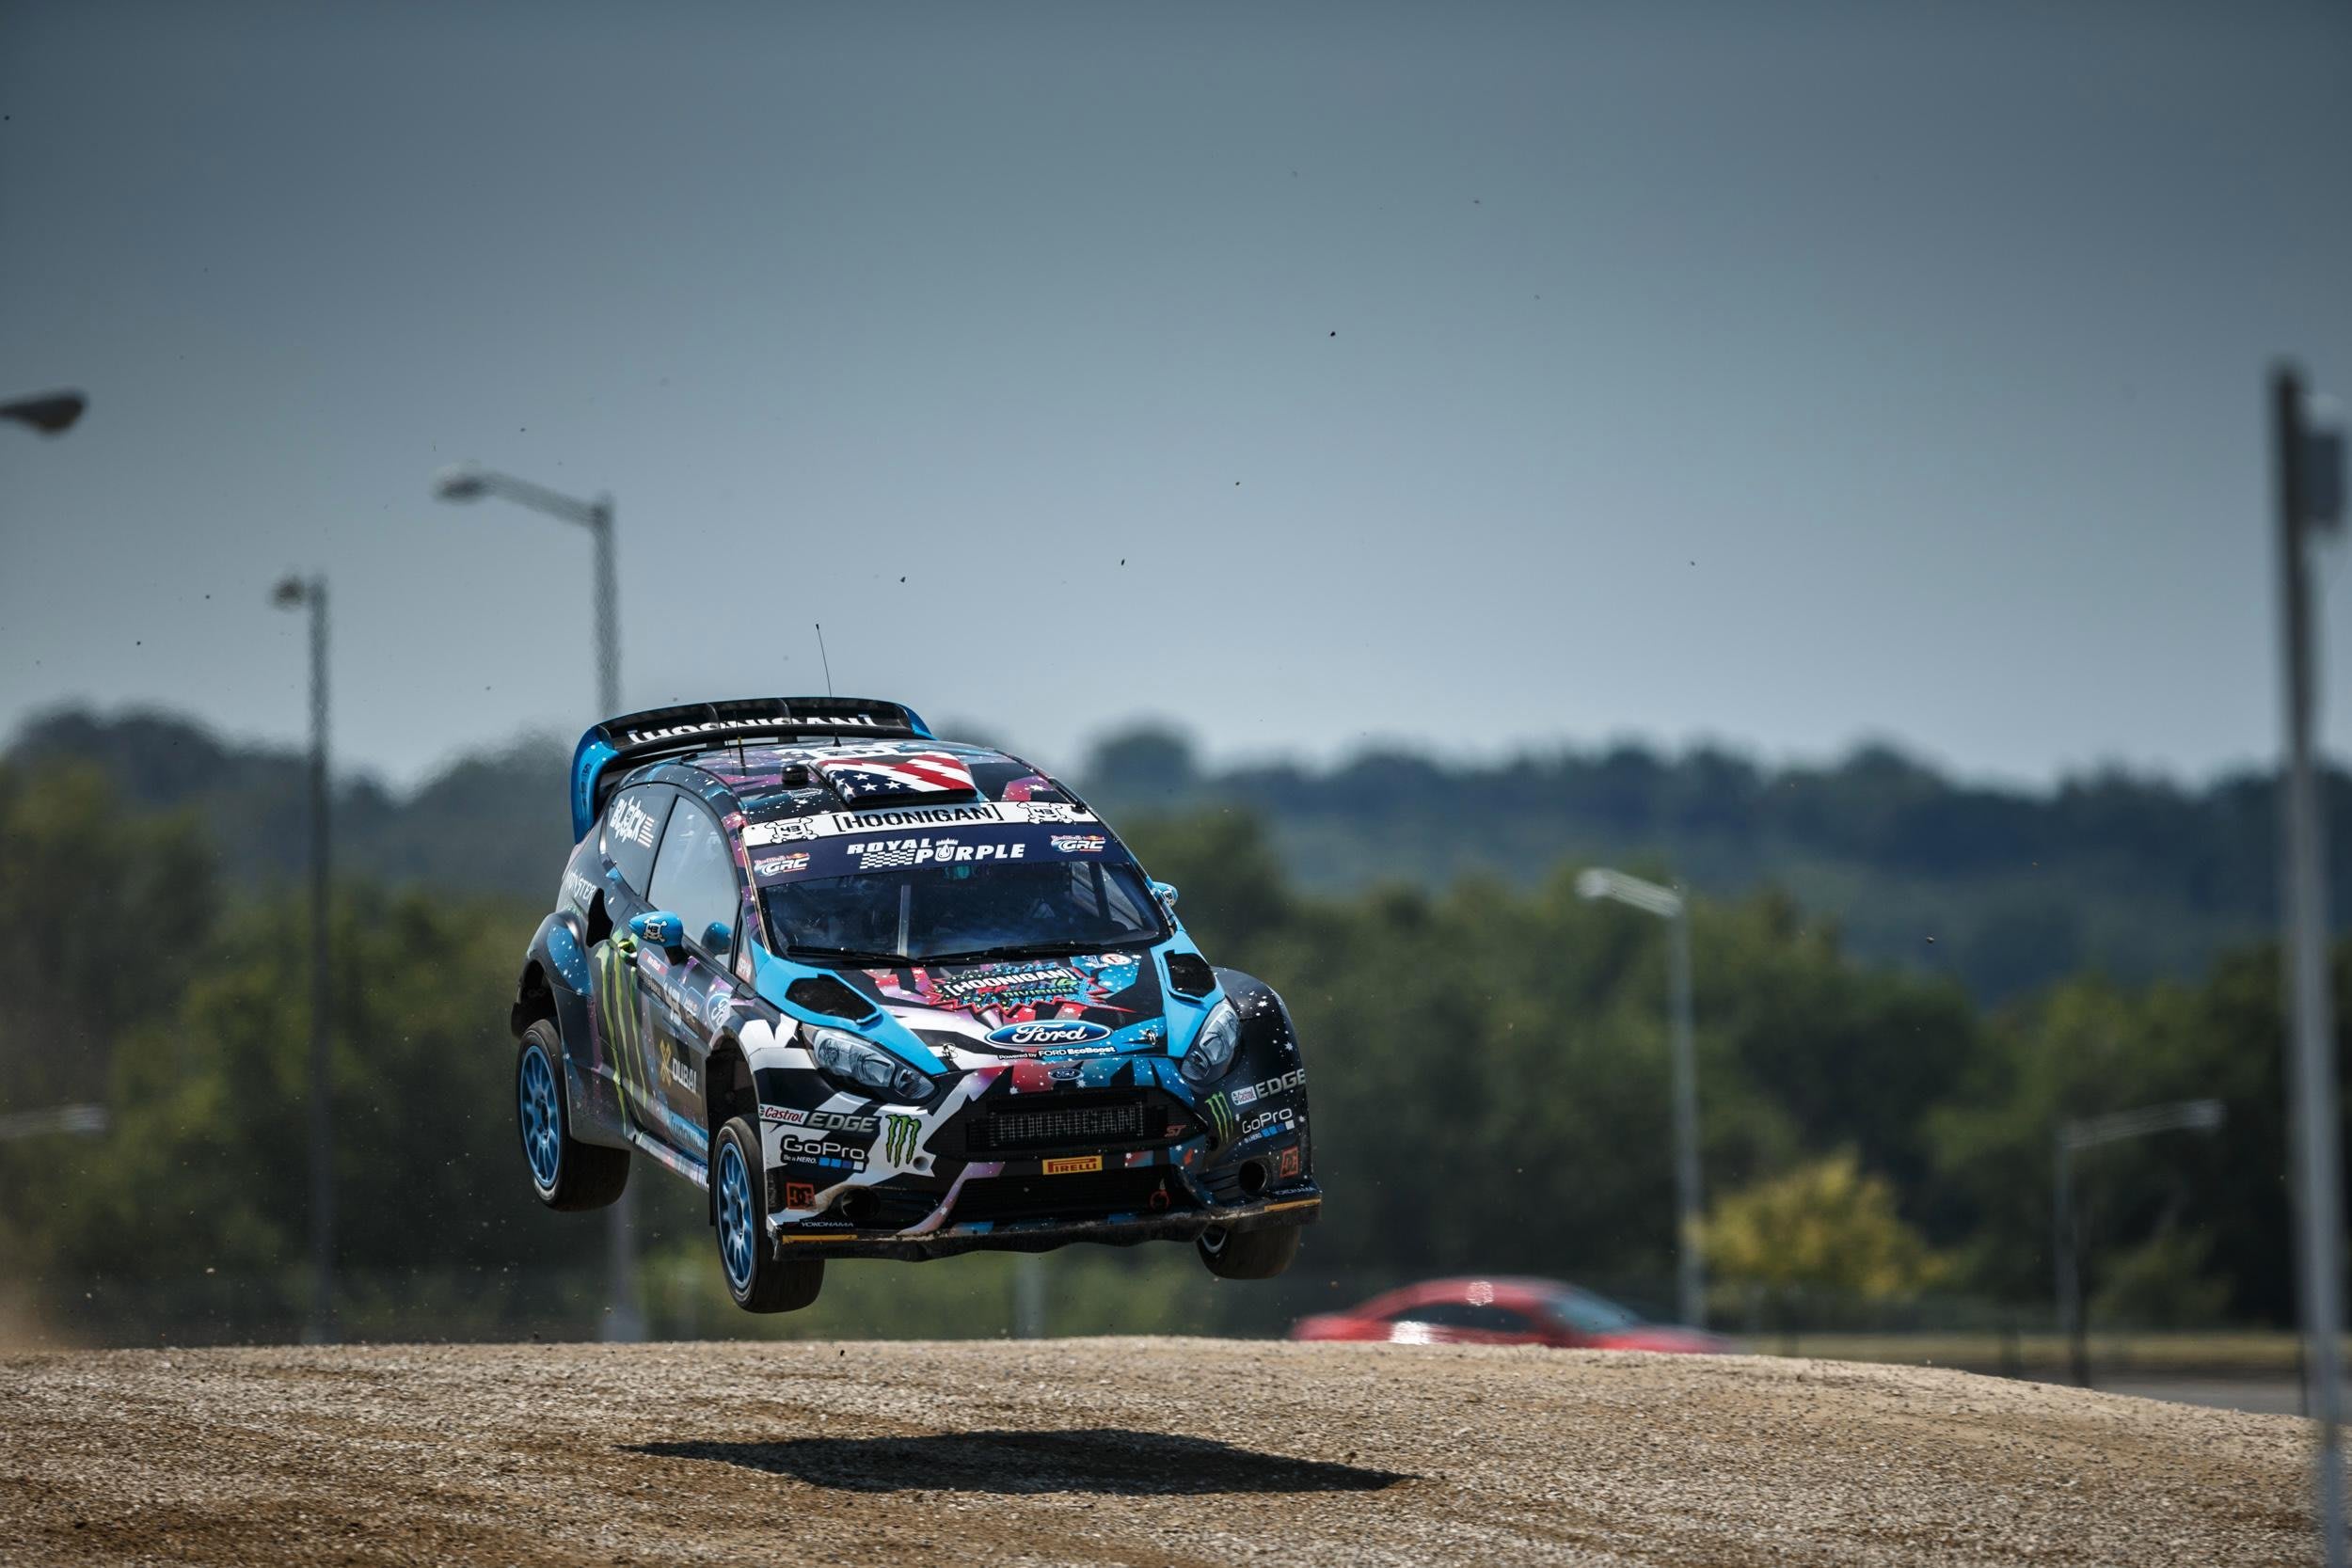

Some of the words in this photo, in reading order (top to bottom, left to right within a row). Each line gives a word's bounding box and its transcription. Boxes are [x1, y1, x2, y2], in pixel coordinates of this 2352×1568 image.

[1035, 807, 1053, 816] 43
[780, 824, 801, 835] 43
[847, 838, 931, 854] ROYAL
[1062, 840, 1106, 850] GRC
[914, 845, 1025, 863] PURPLE
[766, 857, 810, 874] GRC
[1011, 1023, 1088, 1043] Ford
[1068, 1046, 1116, 1054] EcoBoost
[672, 1057, 697, 1094] DUBAI
[1256, 1069, 1306, 1099] EDGE
[764, 1106, 803, 1123] Castrol
[806, 1113, 877, 1132] EDGE
[1242, 1108, 1293, 1134] GoPro
[783, 1137, 866, 1160] GoPro
[1048, 1158, 1097, 1173] PIRELLI
